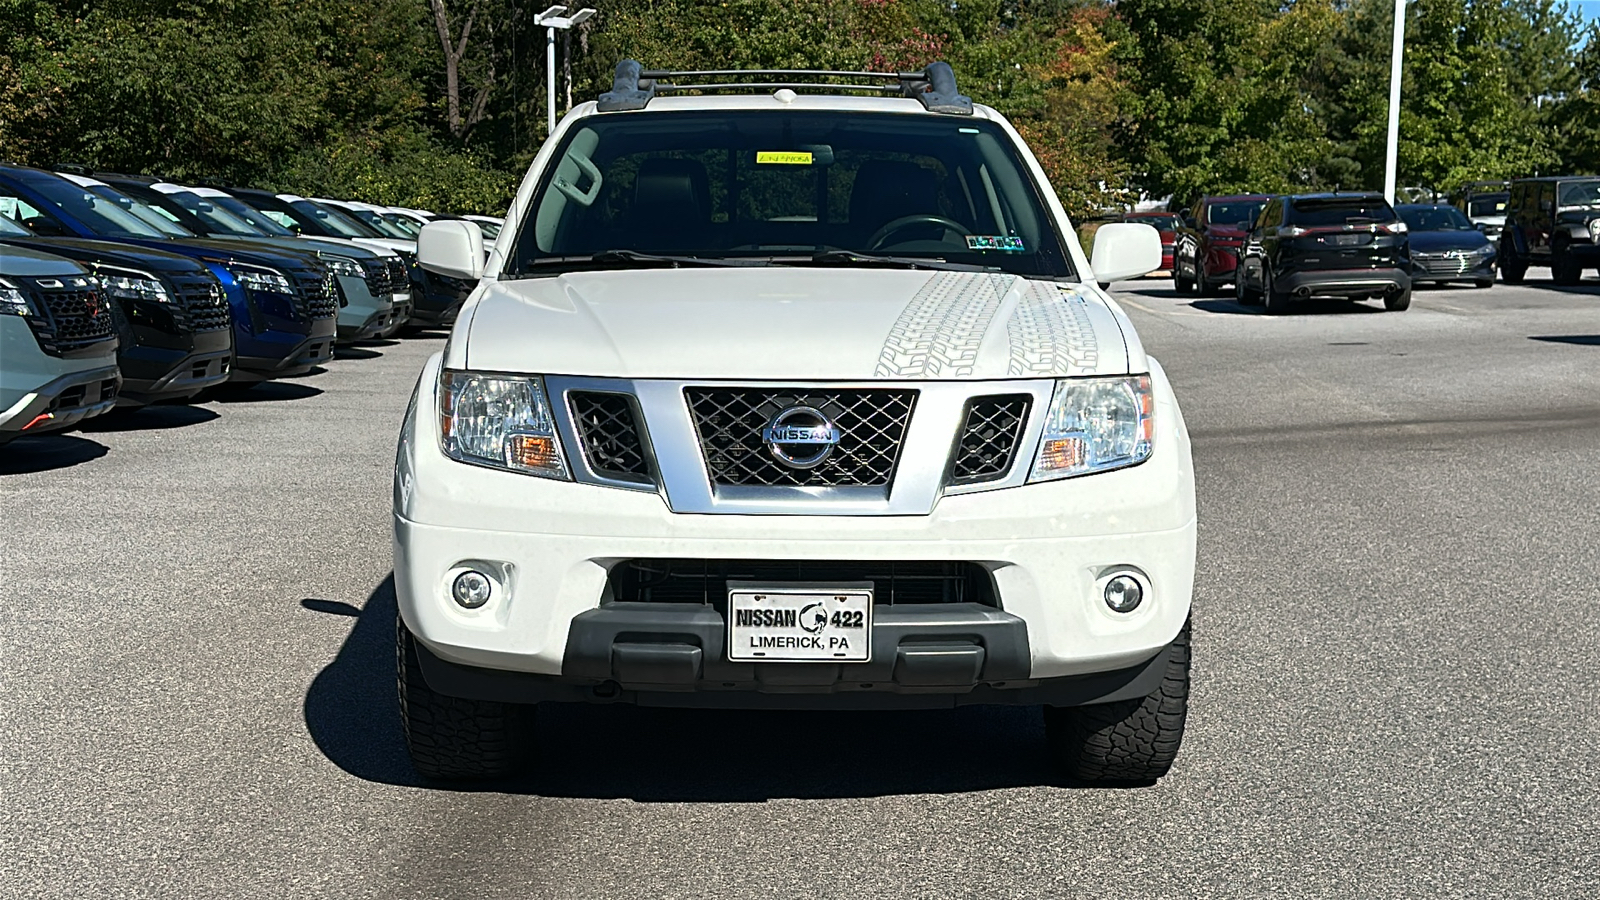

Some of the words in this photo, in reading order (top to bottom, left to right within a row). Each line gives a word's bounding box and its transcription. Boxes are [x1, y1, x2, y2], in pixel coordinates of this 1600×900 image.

[771, 430, 832, 440] NISSAN
[736, 609, 796, 627] NISSAN
[830, 610, 864, 628] 422
[750, 636, 825, 650] LIMERICK,
[829, 637, 849, 649] PA
